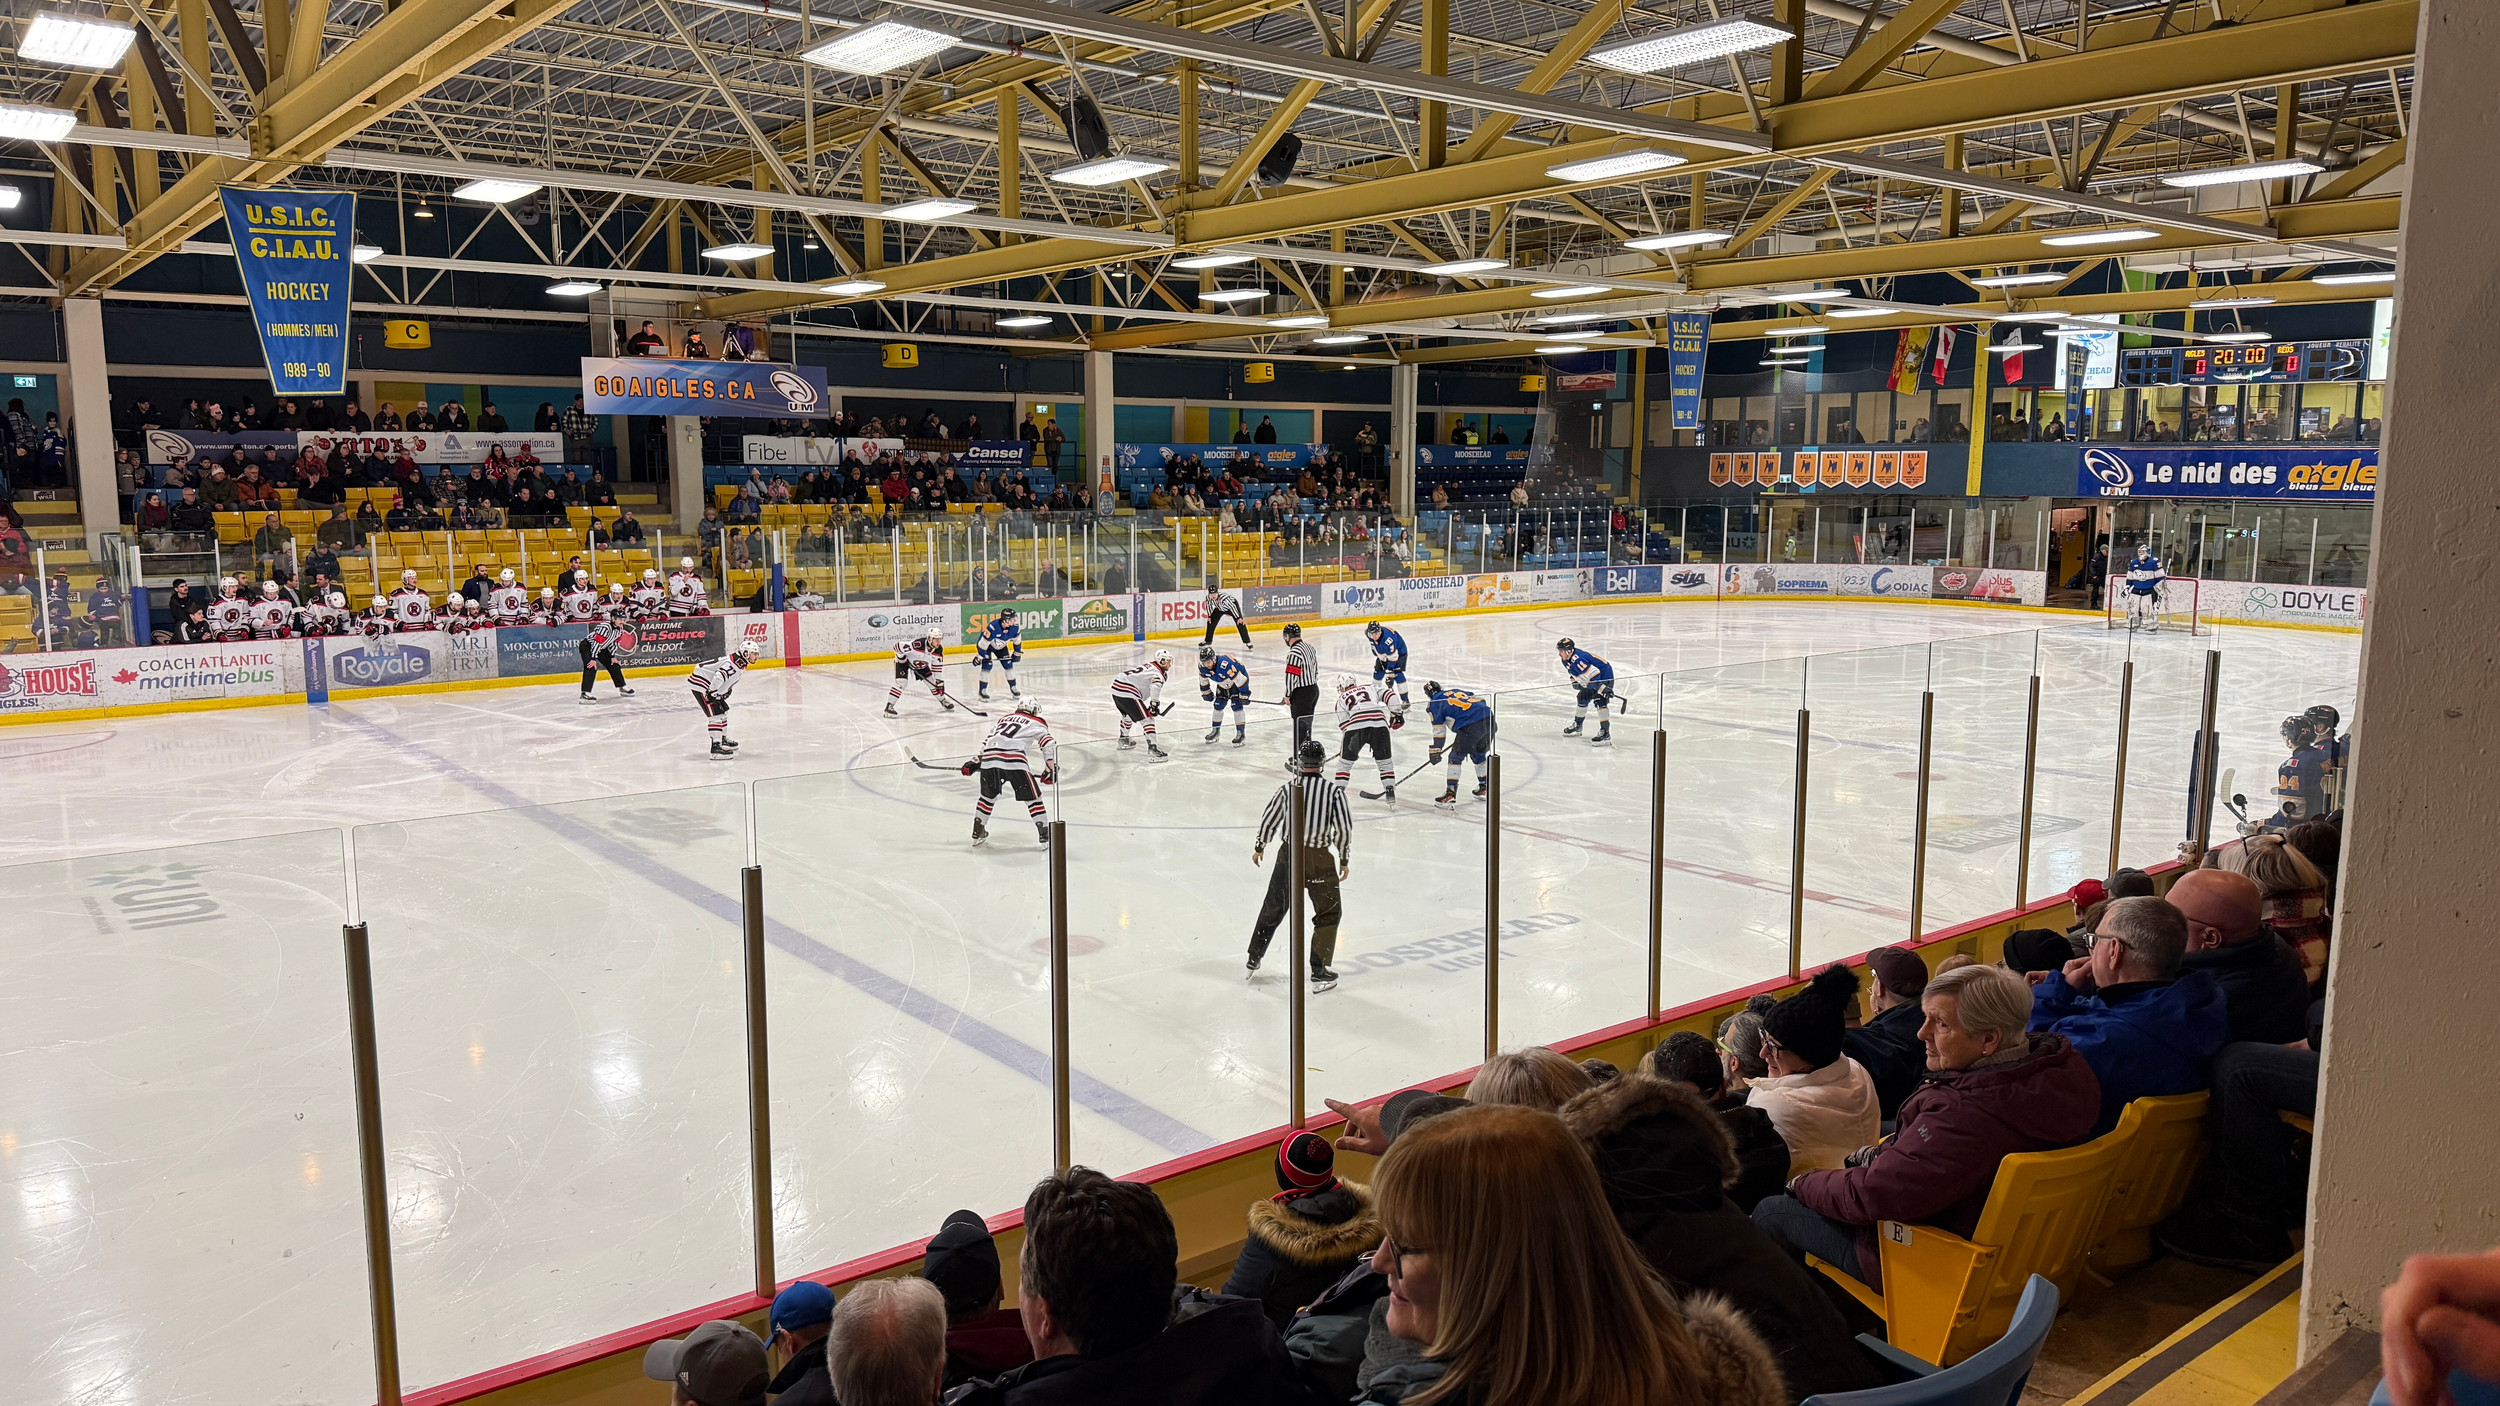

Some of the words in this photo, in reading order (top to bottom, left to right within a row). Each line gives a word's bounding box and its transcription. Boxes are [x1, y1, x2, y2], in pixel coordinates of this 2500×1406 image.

[246, 204, 335, 227] U.S.I.C.
[250, 237, 339, 260] C.I.A.U.
[266, 282, 329, 301] HOCKEY
[406, 324, 419, 340] C
[1673, 322, 1703, 333] U.S.I.C.
[1673, 340, 1701, 352] C.I.A.U.
[901, 348, 912, 360] D
[2214, 348, 2266, 364] 20:00
[1266, 366, 1272, 376] E
[1675, 365, 1696, 375] HOCKEY
[2196, 360, 2206, 374] 0
[2287, 356, 2298, 372] 0
[594, 375, 756, 400] GOAIGLES.CA
[1538, 379, 1544, 388] F
[748, 442, 787, 460] Fibe
[968, 446, 1024, 458] Cansel
[2145, 463, 2173, 482] Le
[2180, 462, 2222, 484] nid
[2230, 463, 2277, 484] des
[2288, 458, 2378, 490] aigle
[1400, 576, 1464, 590] MOOSEHEAD
[1607, 569, 1637, 592] Bell
[1777, 580, 1828, 588] SOPREMA
[1844, 576, 1866, 585] 93.5
[1989, 574, 2012, 588] plus
[1272, 594, 1312, 607] FunTime
[1334, 586, 1385, 604] LLOYD'S
[1423, 591, 1440, 600] LIGHT
[2282, 591, 2356, 612] DOYLE
[641, 622, 682, 630] MARITIME
[893, 614, 944, 625] Gallagher
[1071, 614, 1124, 629] Cavendish
[641, 631, 657, 641] La
[659, 630, 706, 640] Source
[744, 623, 767, 636] IGA
[504, 640, 559, 652] MONCTON
[563, 640, 581, 648] MR
[516, 650, 573, 660] 1-855-897-4476
[138, 658, 195, 672] COACH
[200, 653, 273, 668] ATLANTIC
[341, 652, 424, 683] Royale
[25, 662, 94, 694] HOUSE
[139, 667, 274, 690] maritimebus
[1345, 691, 1372, 710] 23
[994, 723, 1022, 739] 20
[1893, 1222, 1903, 1243] E
